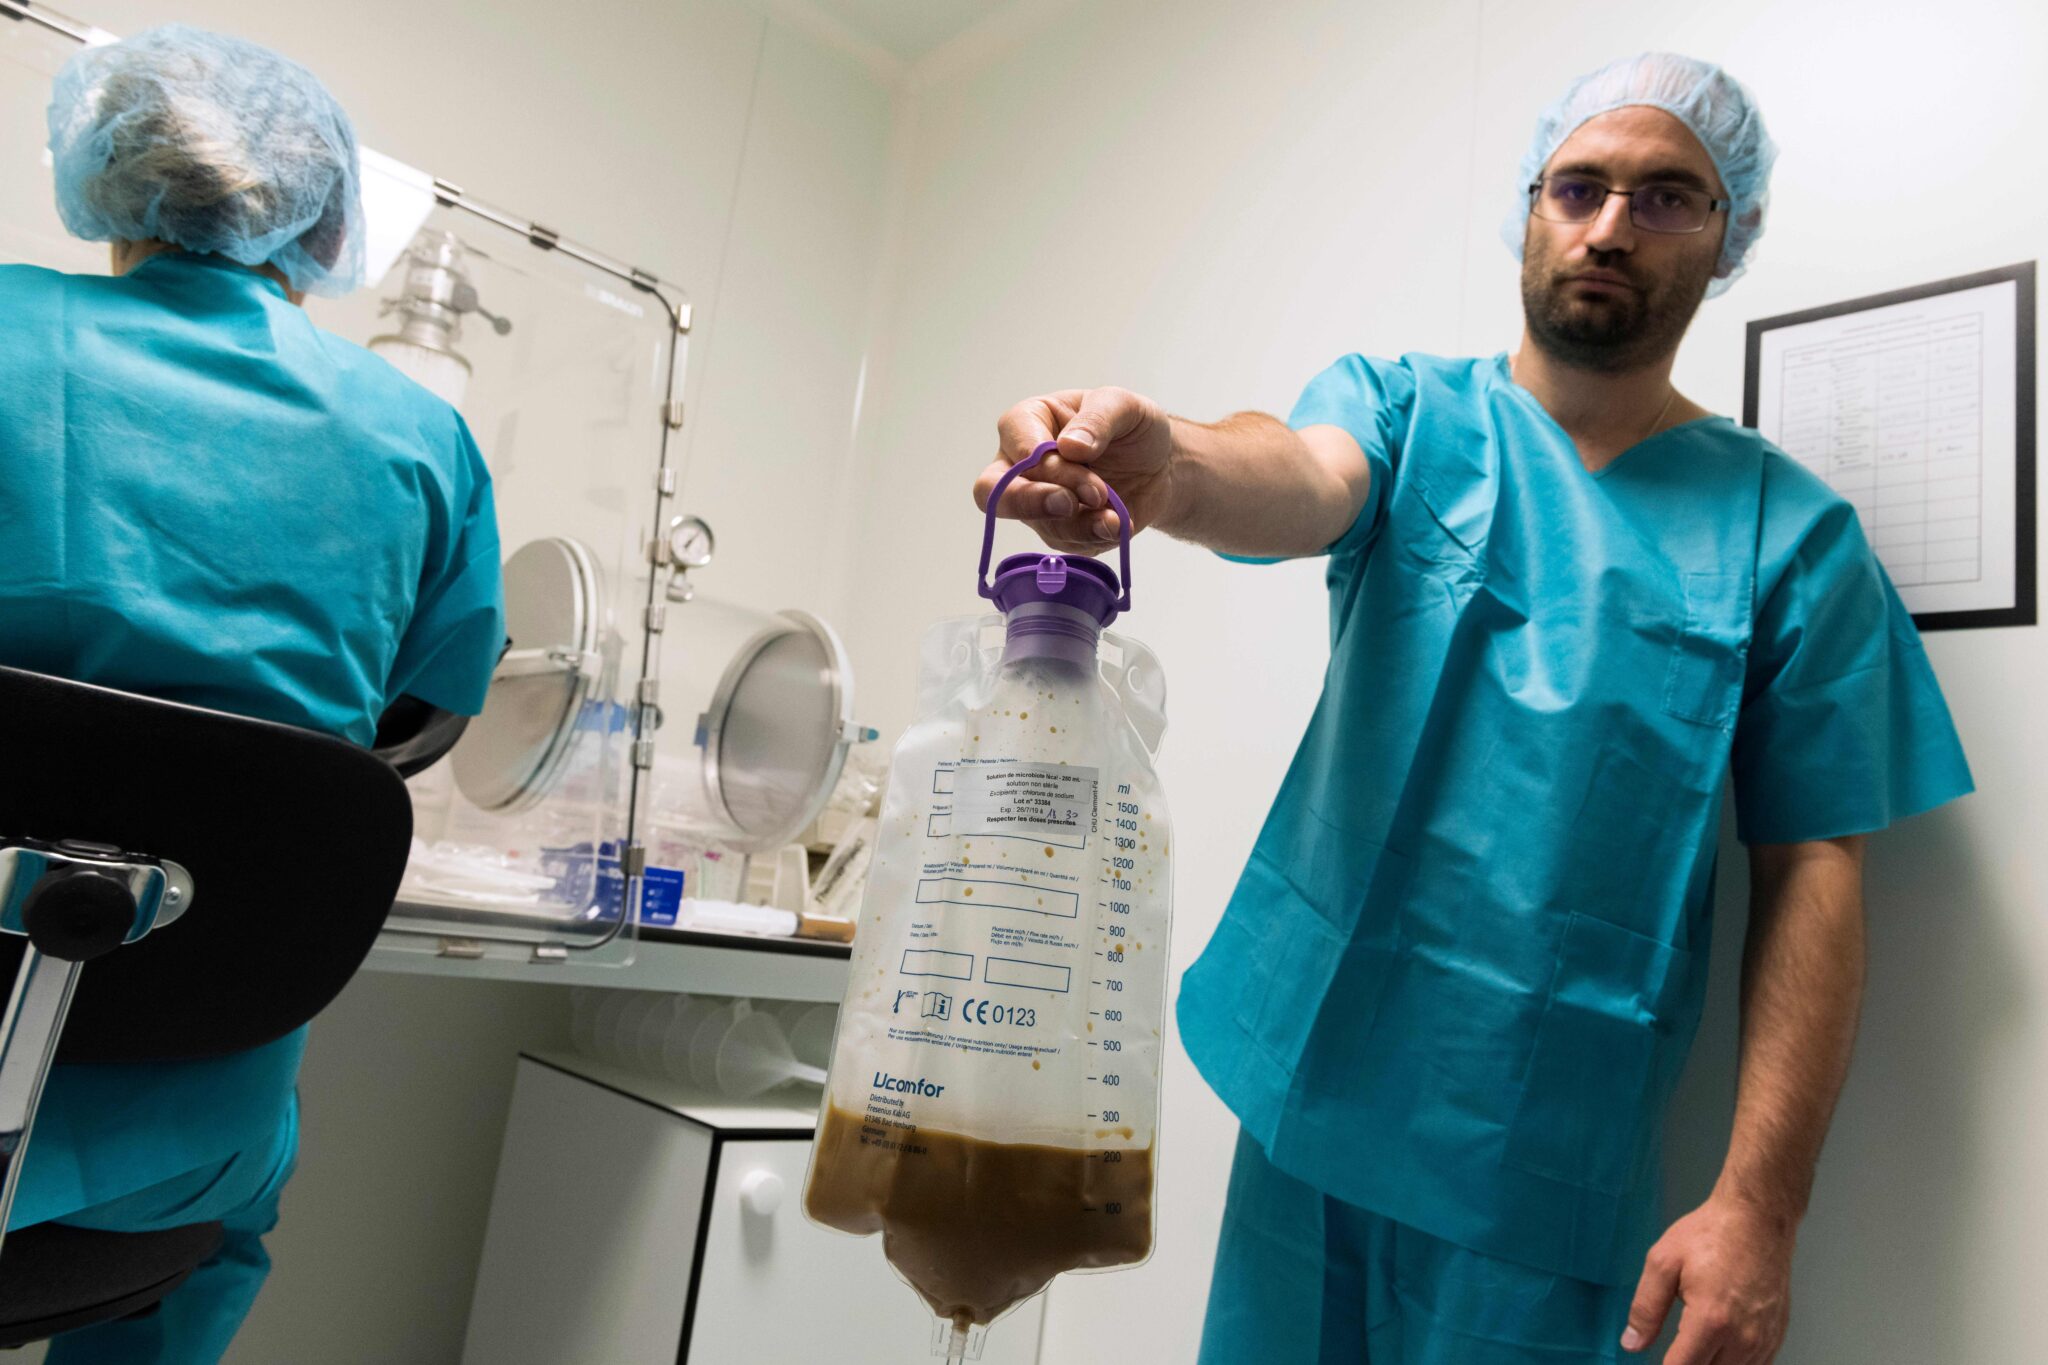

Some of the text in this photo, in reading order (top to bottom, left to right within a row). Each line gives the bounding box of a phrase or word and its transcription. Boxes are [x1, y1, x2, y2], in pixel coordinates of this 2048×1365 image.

[1117, 784, 1130, 796] ml
[1117, 802, 1139, 816] 1500
[1048, 818, 1076, 826] prescrites
[1115, 818, 1137, 832] 1400
[1114, 836, 1136, 850] 1300
[1112, 857, 1134, 870] 1200
[1111, 878, 1132, 892] 1100
[1109, 902, 1130, 914] 1000
[1109, 926, 1126, 938] 900
[1107, 951, 1124, 963] 800
[1106, 979, 1123, 992] 700
[992, 1005, 1036, 1028] 0123
[1104, 1010, 1122, 1022] 600
[1103, 1041, 1122, 1052] 500
[873, 1072, 945, 1098] Ucomfor
[1102, 1074, 1120, 1086] 400
[870, 1094, 900, 1106] Distributed
[867, 1104, 892, 1116] Fresenius
[902, 1111, 911, 1120] AG
[1102, 1111, 1120, 1122] 300
[1103, 1151, 1122, 1163] 200
[1105, 1202, 1122, 1215] 100
